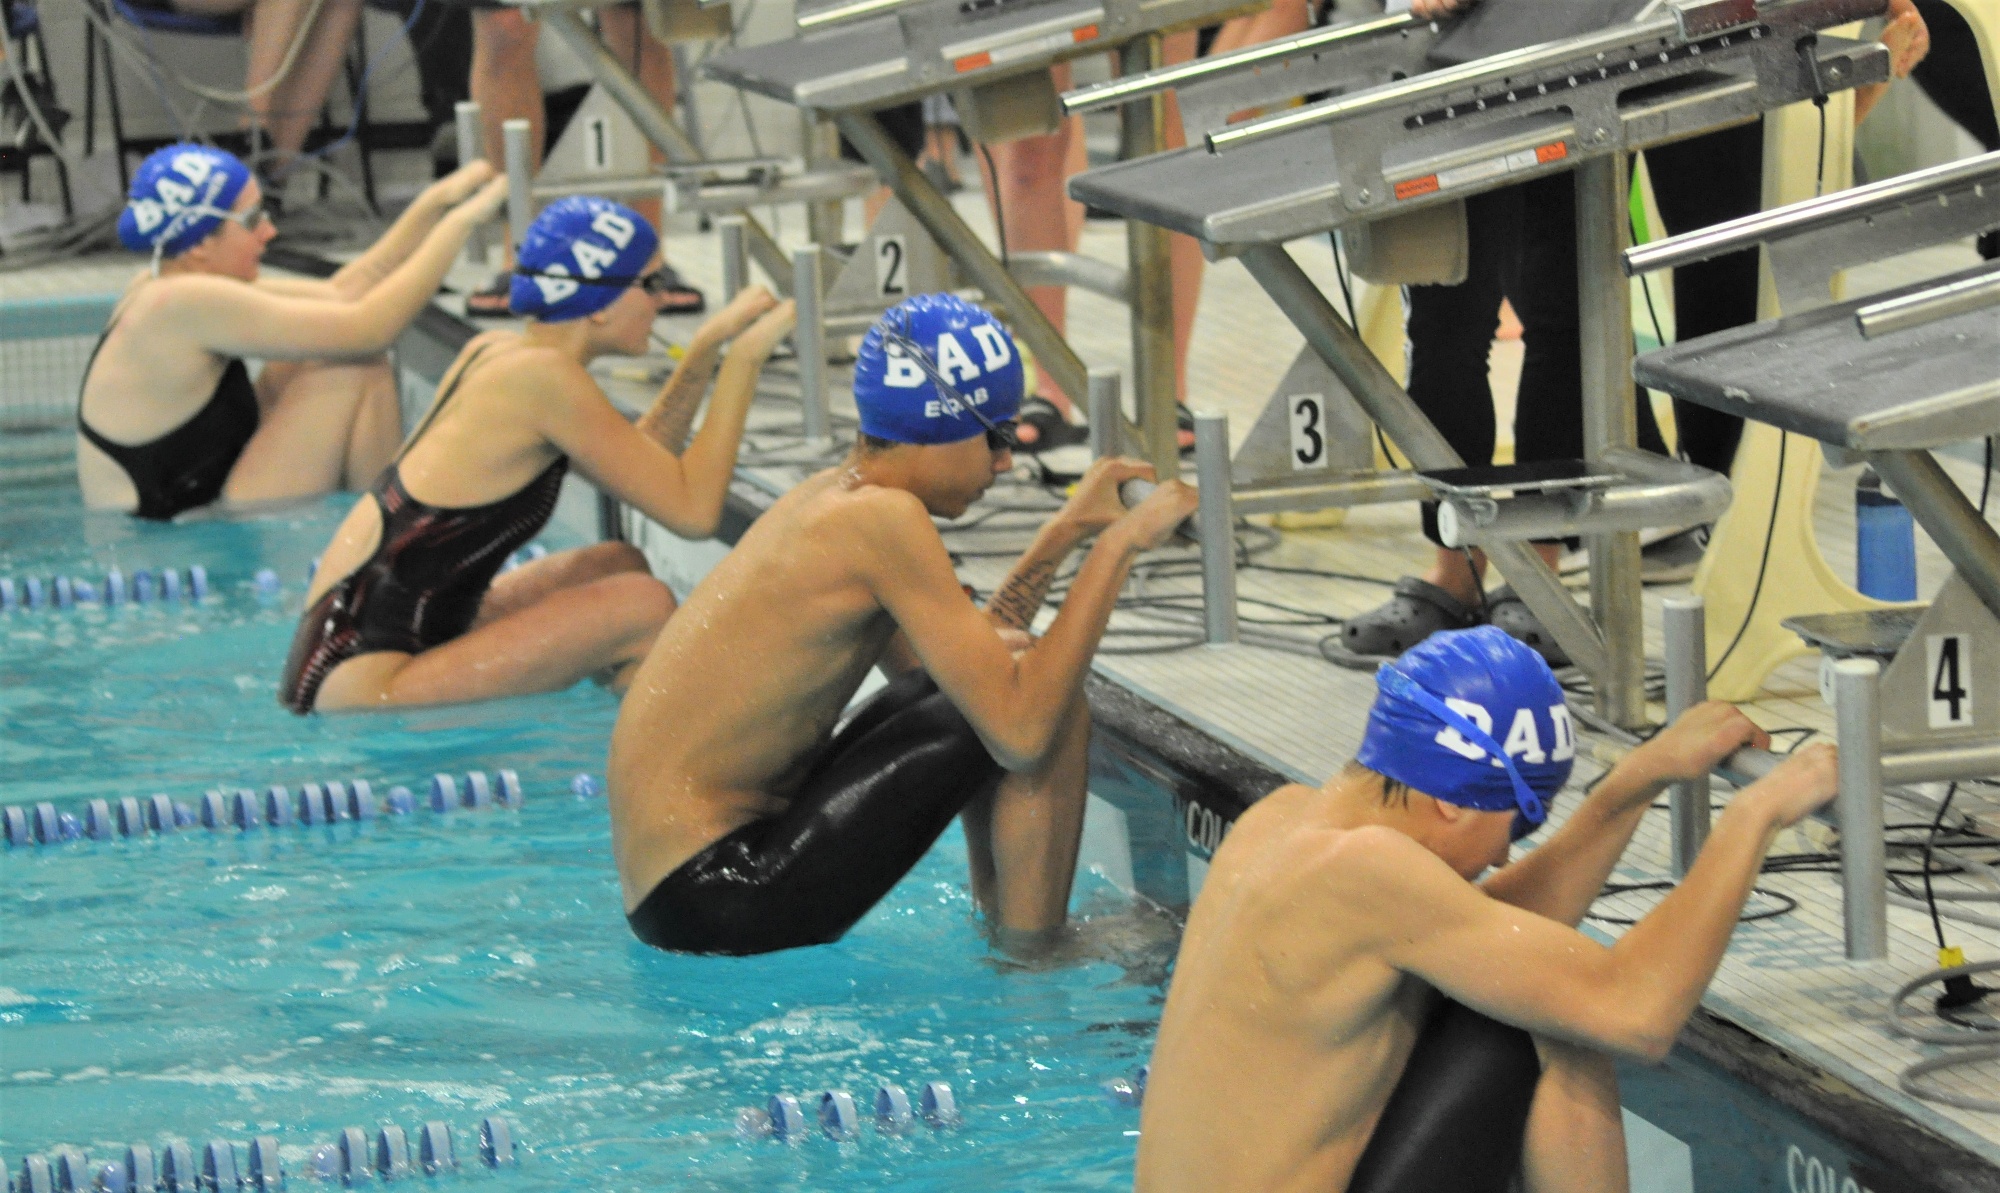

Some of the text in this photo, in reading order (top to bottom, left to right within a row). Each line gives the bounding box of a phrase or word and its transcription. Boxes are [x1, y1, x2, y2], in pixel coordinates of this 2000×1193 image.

[592, 120, 604, 167] 1
[129, 152, 212, 235] BAD
[532, 211, 635, 305] BAD
[881, 240, 903, 294] 2
[884, 322, 1012, 388] BAD
[1296, 398, 1323, 464] 3
[1933, 637, 1966, 720] 4
